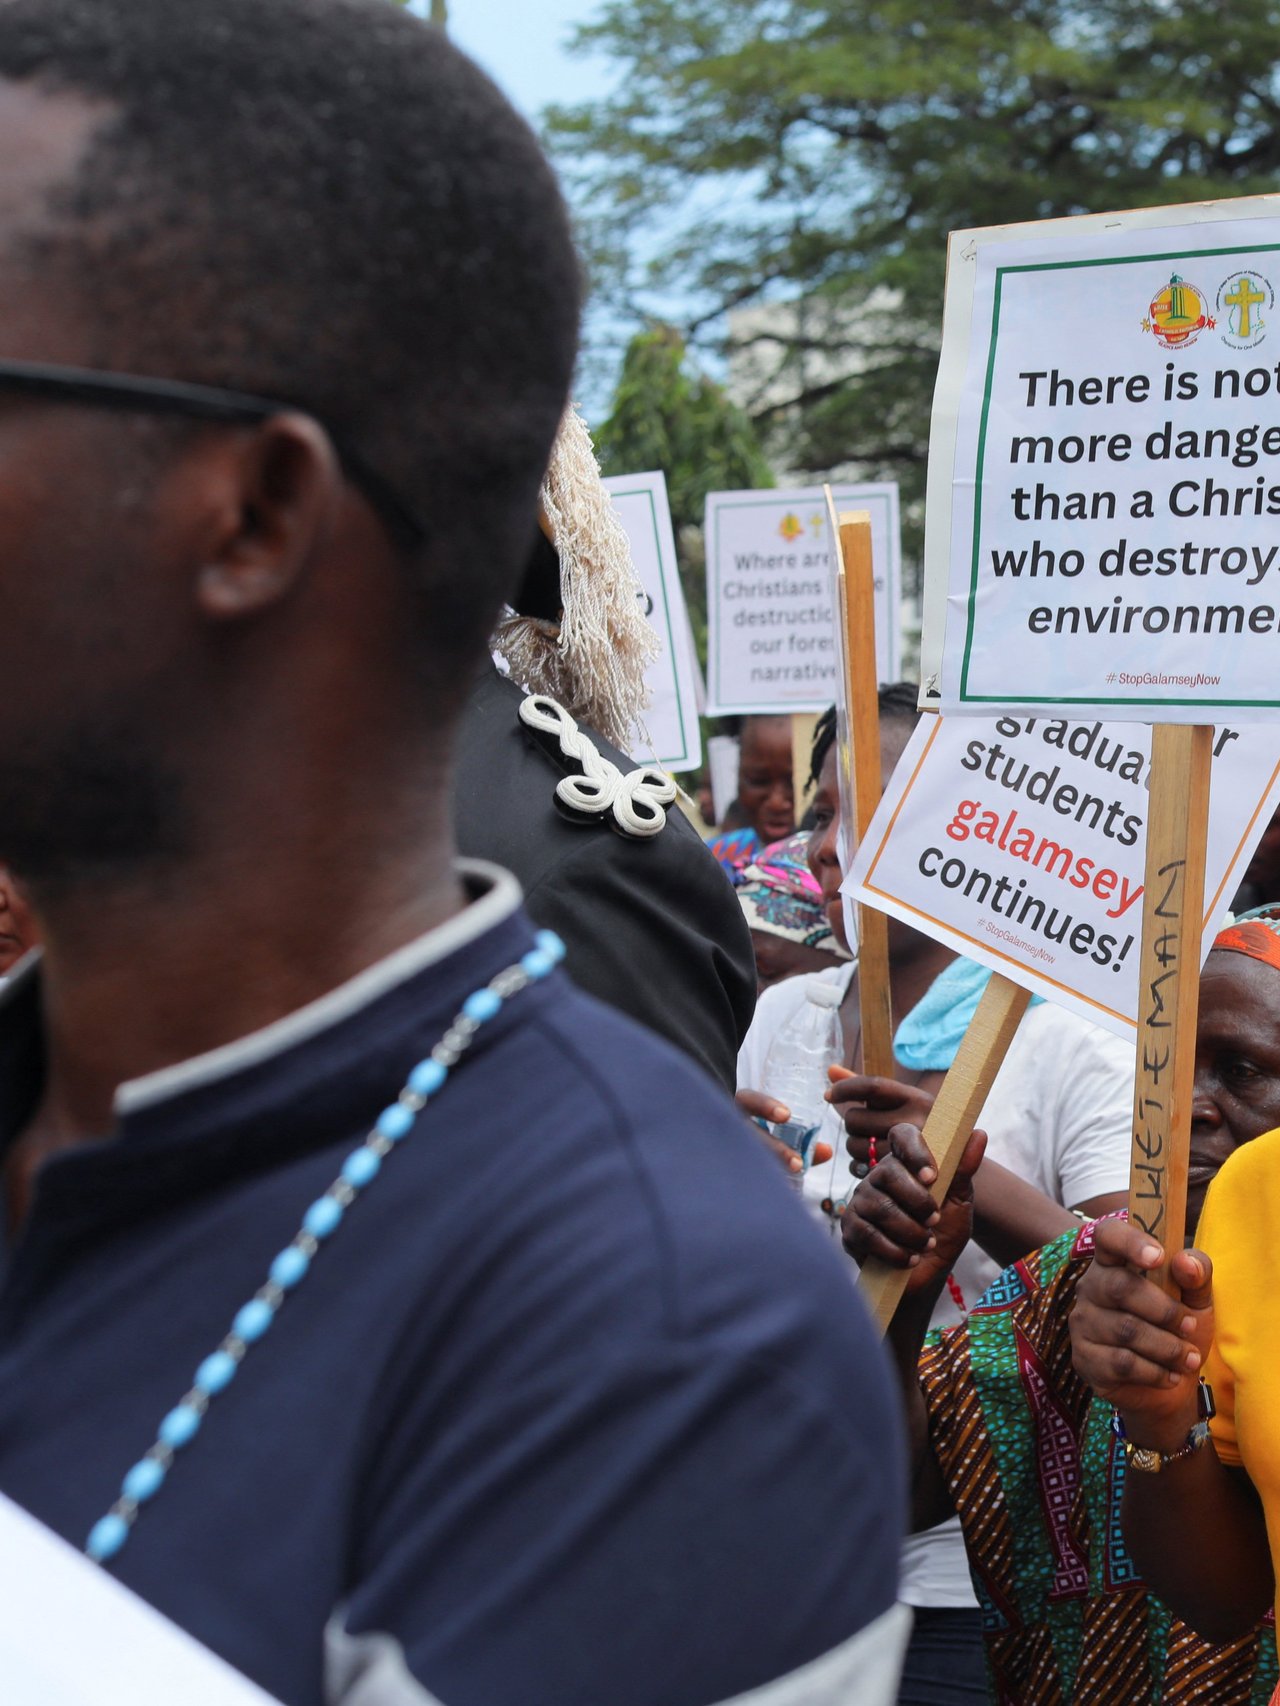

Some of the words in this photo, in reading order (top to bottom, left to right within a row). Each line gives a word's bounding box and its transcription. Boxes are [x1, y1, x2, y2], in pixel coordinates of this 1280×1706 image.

[1019, 369, 1150, 407] There
[1164, 362, 1199, 401] is
[1010, 430, 1131, 464] more
[1011, 484, 1116, 520] than
[1130, 490, 1154, 518] a
[734, 552, 797, 571] Where
[992, 542, 1085, 578] who
[723, 579, 821, 600] Christians
[750, 638, 787, 653] our
[1119, 671, 1220, 687] StopGalamseyNow
[995, 717, 1151, 791] gradua
[960, 737, 1144, 847] students
[946, 800, 1144, 918] galamsey
[919, 848, 1134, 972] continues!
[986, 922, 1056, 964] StopGalamseyNow
